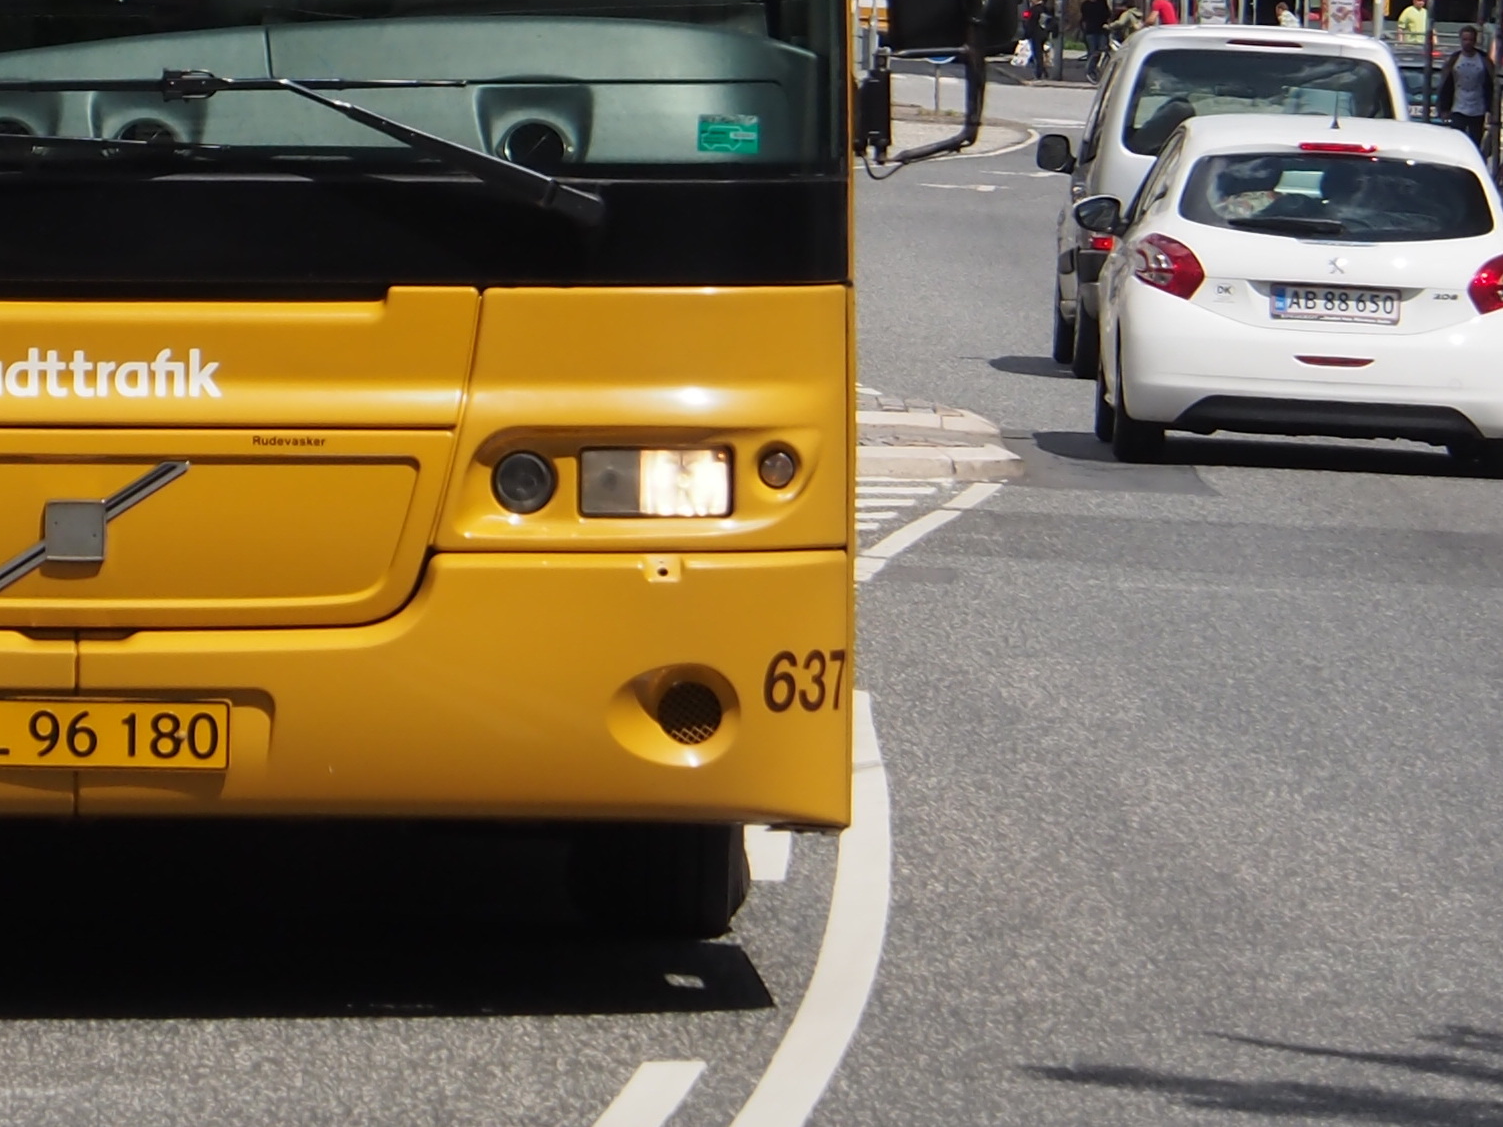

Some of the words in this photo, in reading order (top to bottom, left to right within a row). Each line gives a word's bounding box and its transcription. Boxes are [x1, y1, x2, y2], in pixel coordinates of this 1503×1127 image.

[1216, 285, 1232, 295] DK
[1288, 290, 1317, 310] AB
[1324, 291, 1350, 312] 88
[1356, 293, 1395, 315] 650
[252, 436, 326, 446] Rudevasker
[763, 649, 846, 713] 637
[27, 709, 98, 759] 96
[120, 710, 221, 760] 180
